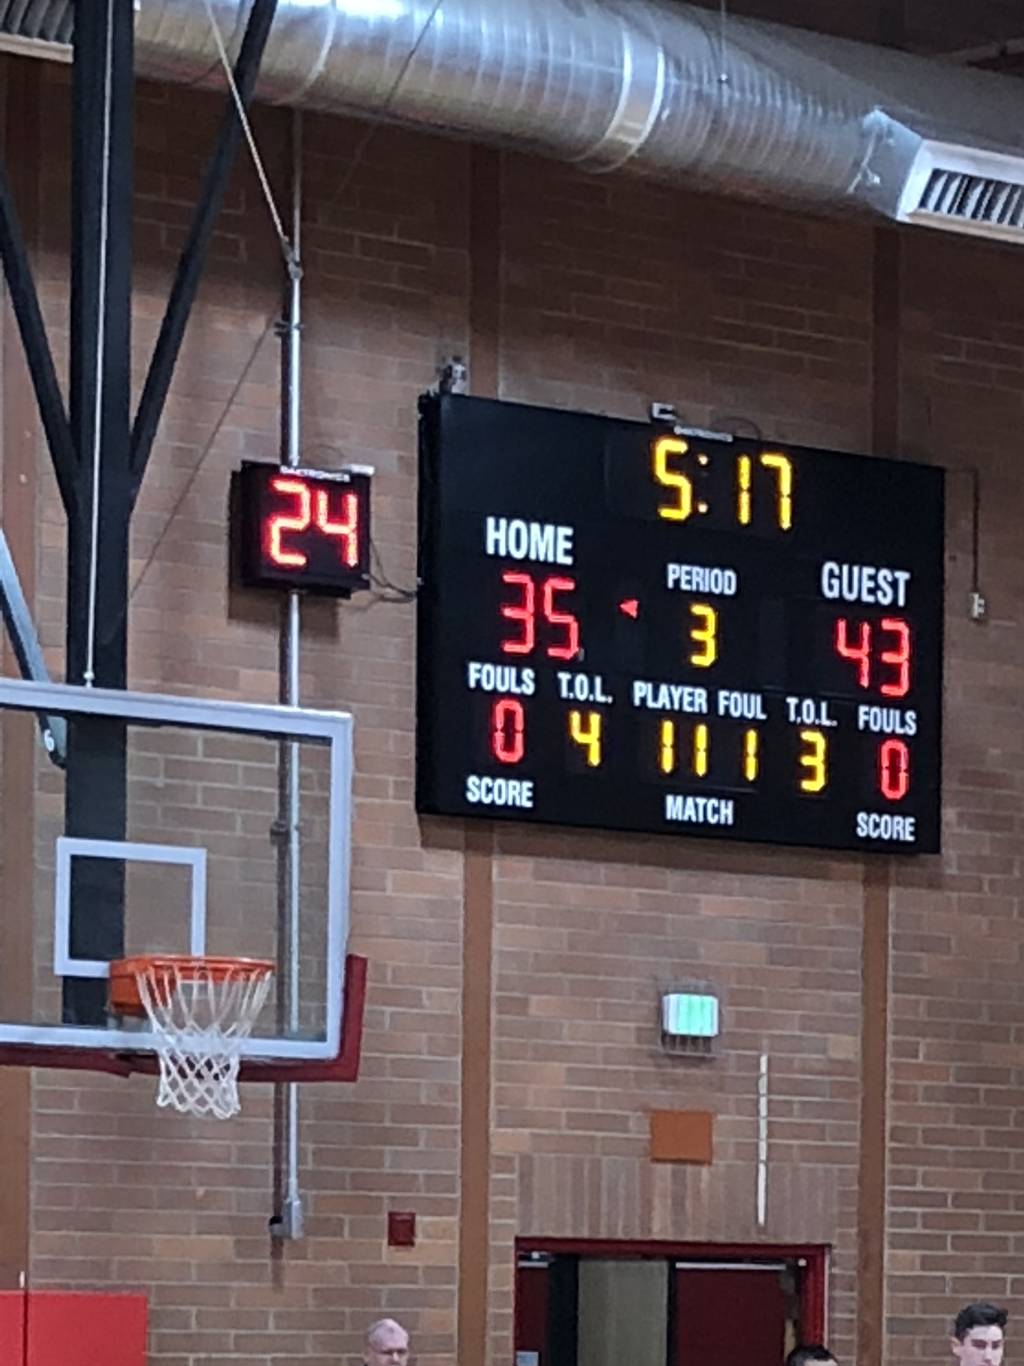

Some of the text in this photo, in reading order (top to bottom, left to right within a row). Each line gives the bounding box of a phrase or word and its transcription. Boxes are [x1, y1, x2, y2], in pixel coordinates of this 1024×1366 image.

[654, 437, 792, 530] 5:17
[270, 479, 358, 567] 24
[486, 516, 574, 565] HOME
[667, 563, 737, 596] PERIOD
[821, 561, 911, 607] GUEST
[502, 572, 580, 660] 35
[689, 604, 717, 667] 3
[468, 661, 535, 696] FOULS
[836, 617, 911, 696] 43
[557, 671, 613, 704] T.O.L.
[633, 680, 767, 720] PLAYER FOUL
[492, 699, 525, 764] 0
[785, 697, 838, 727] T.O.L.
[858, 705, 917, 736] FOULS
[569, 710, 601, 767] 4
[800, 731, 826, 792] 3
[465, 774, 534, 808] SCORE
[880, 739, 909, 800] 0
[665, 794, 734, 825] MATCH
[856, 811, 916, 842] SCORE
